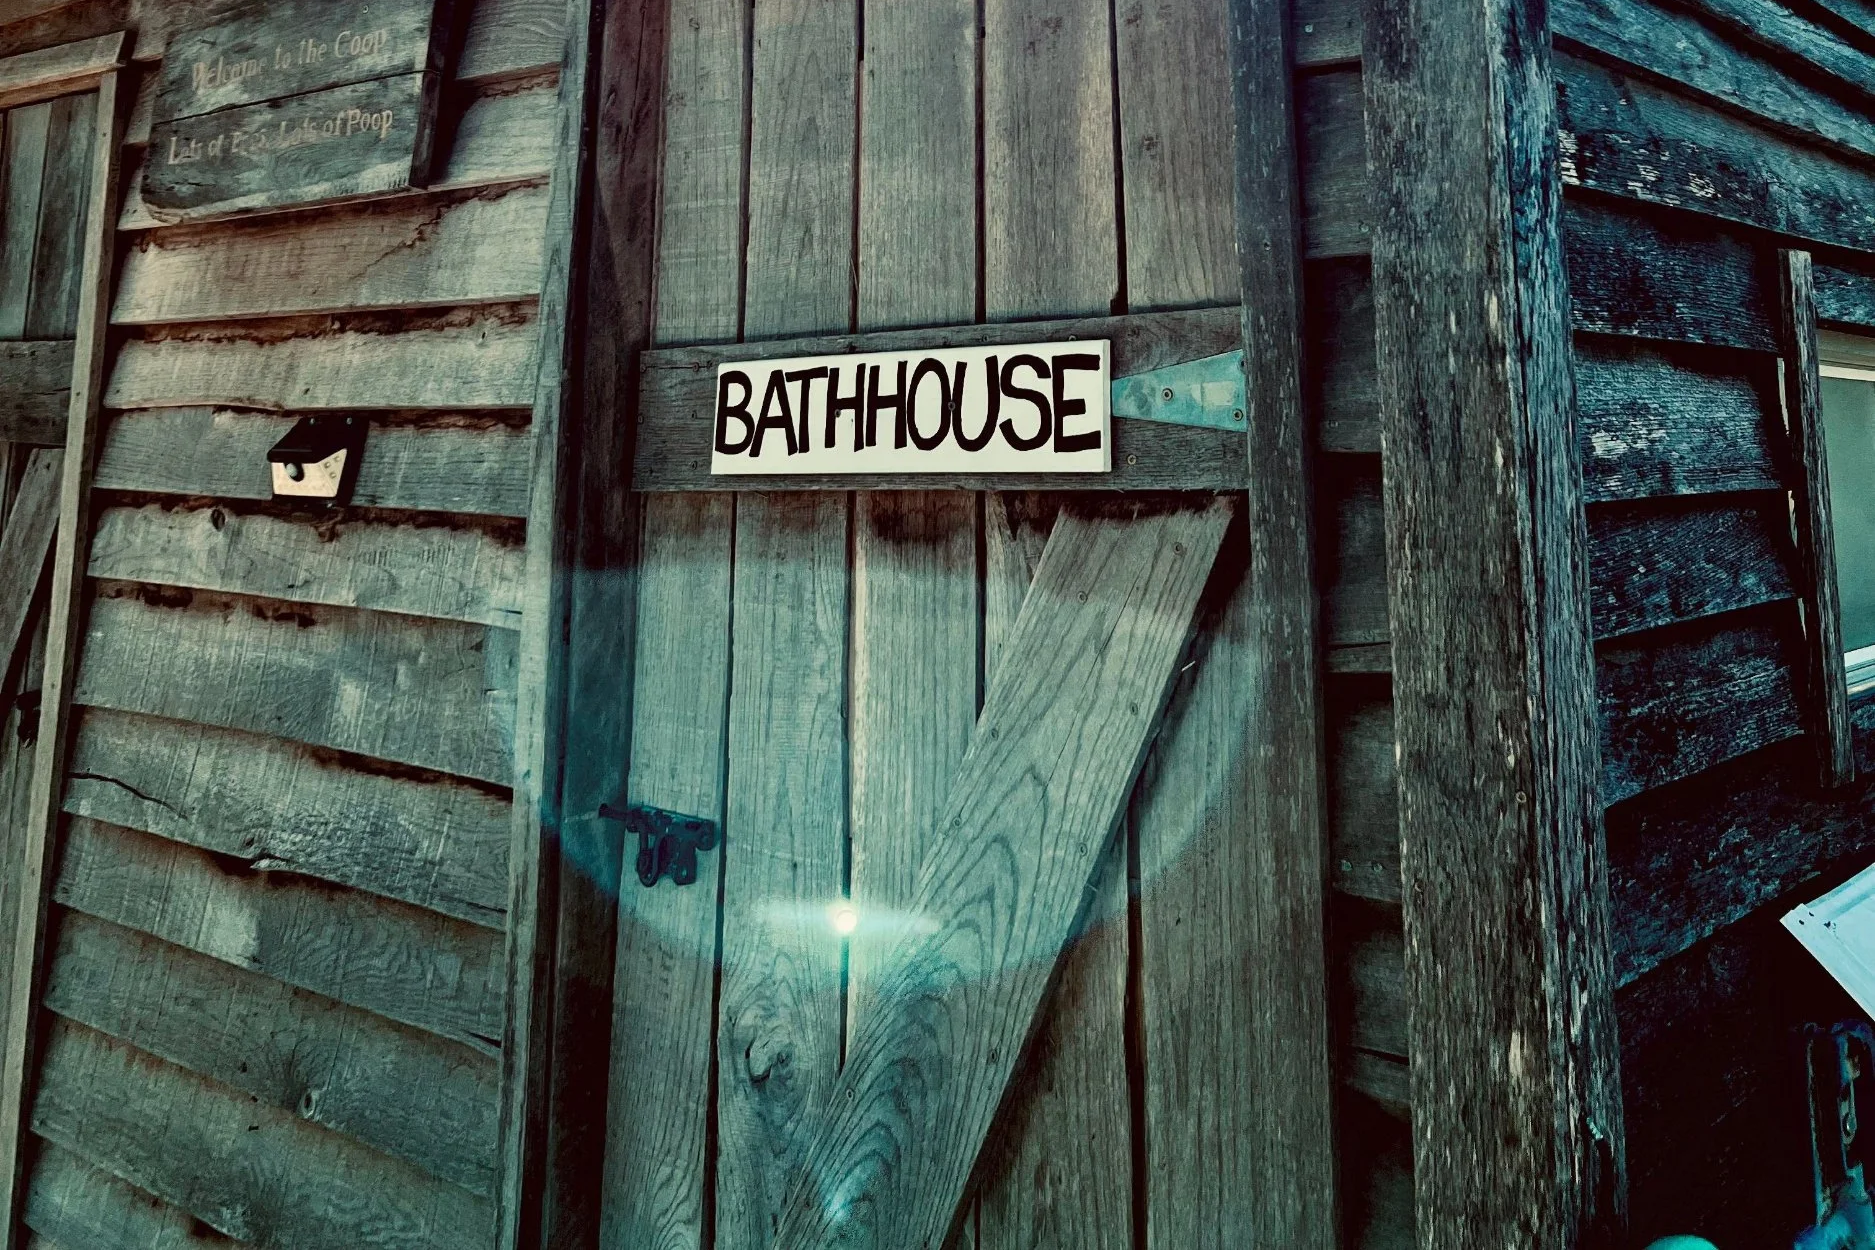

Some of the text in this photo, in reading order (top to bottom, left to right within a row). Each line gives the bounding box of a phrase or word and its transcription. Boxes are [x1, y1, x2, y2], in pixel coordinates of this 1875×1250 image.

[191, 29, 387, 91] Welcome to the Coop
[323, 110, 345, 137] of
[346, 108, 393, 143] Poop
[714, 354, 1102, 458] BATHHOUSE
